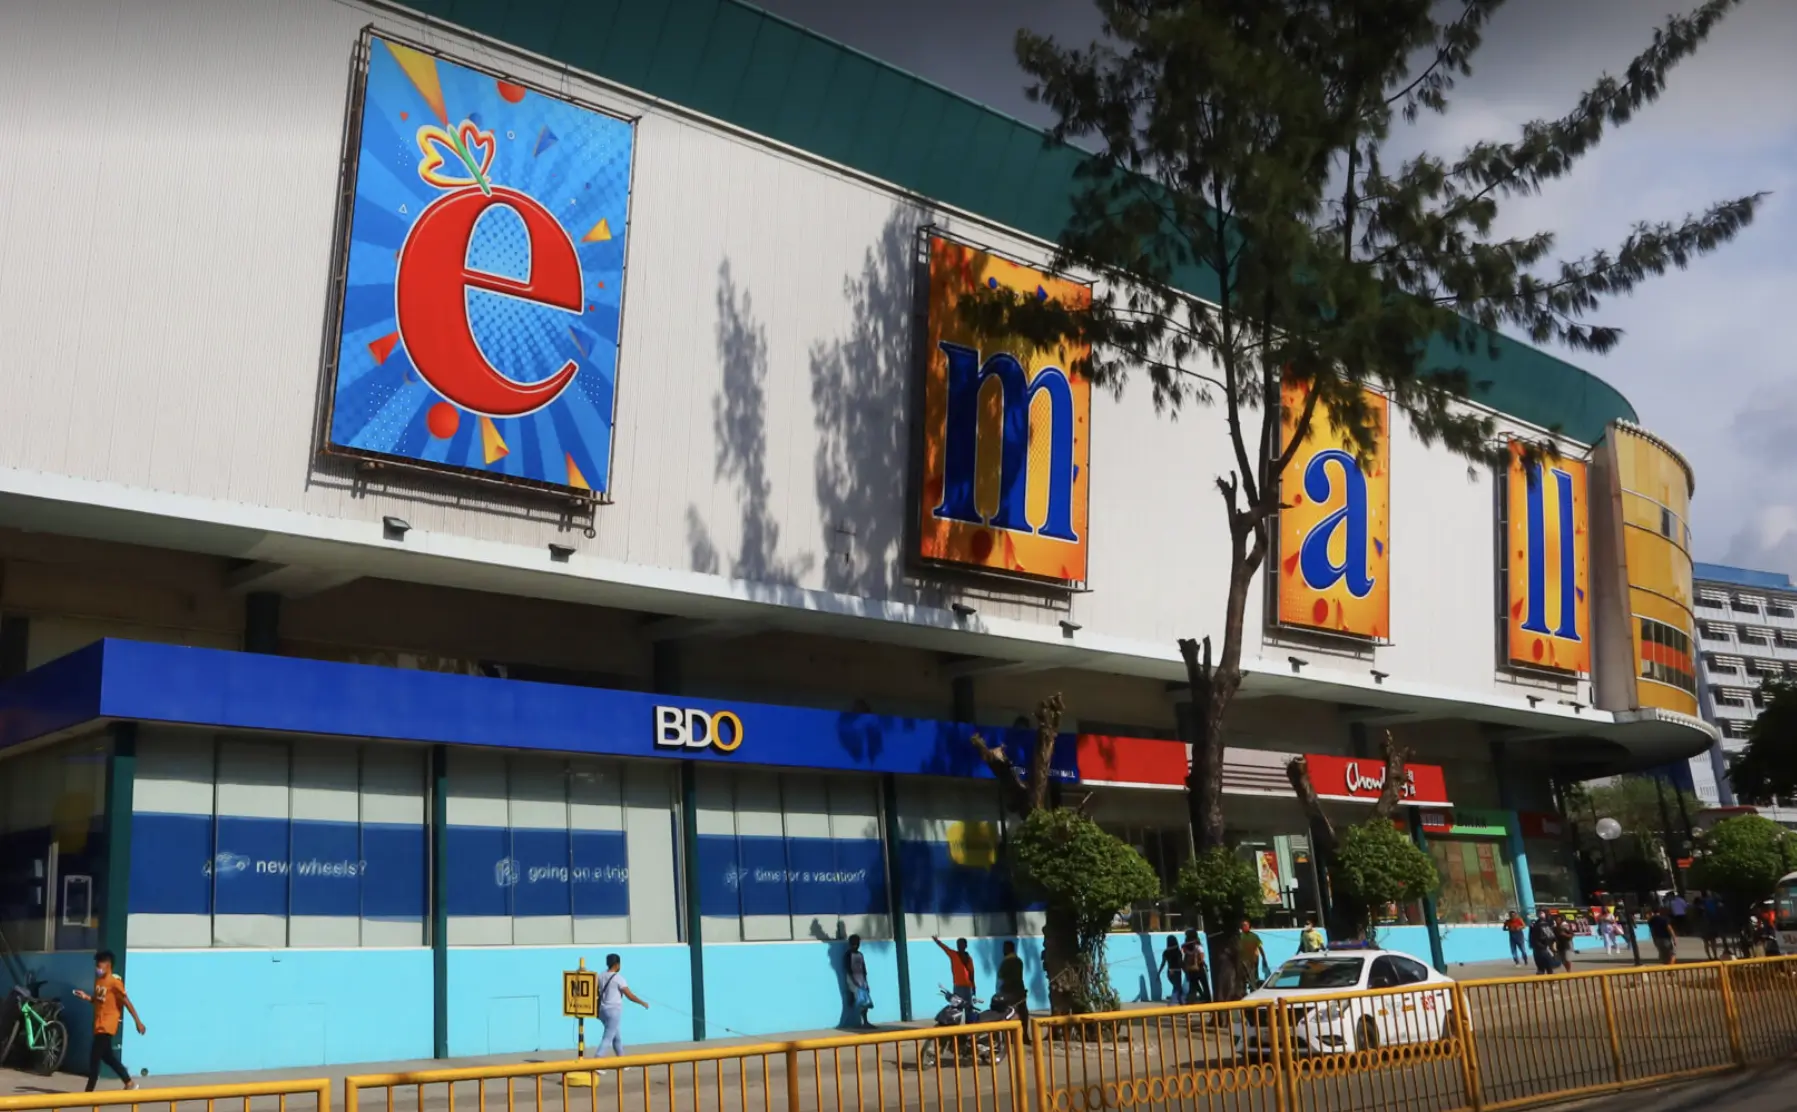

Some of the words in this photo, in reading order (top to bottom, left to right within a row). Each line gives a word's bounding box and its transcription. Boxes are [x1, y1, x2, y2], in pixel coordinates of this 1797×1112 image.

[655, 705, 744, 752] BDO
[256, 860, 292, 874] new
[298, 858, 367, 877] wheels?
[528, 863, 568, 883] going
[573, 866, 591, 880] on
[755, 867, 781, 882] time
[803, 871, 810, 882] a
[813, 868, 866, 883] vacation?
[571, 980, 590, 997] NO
